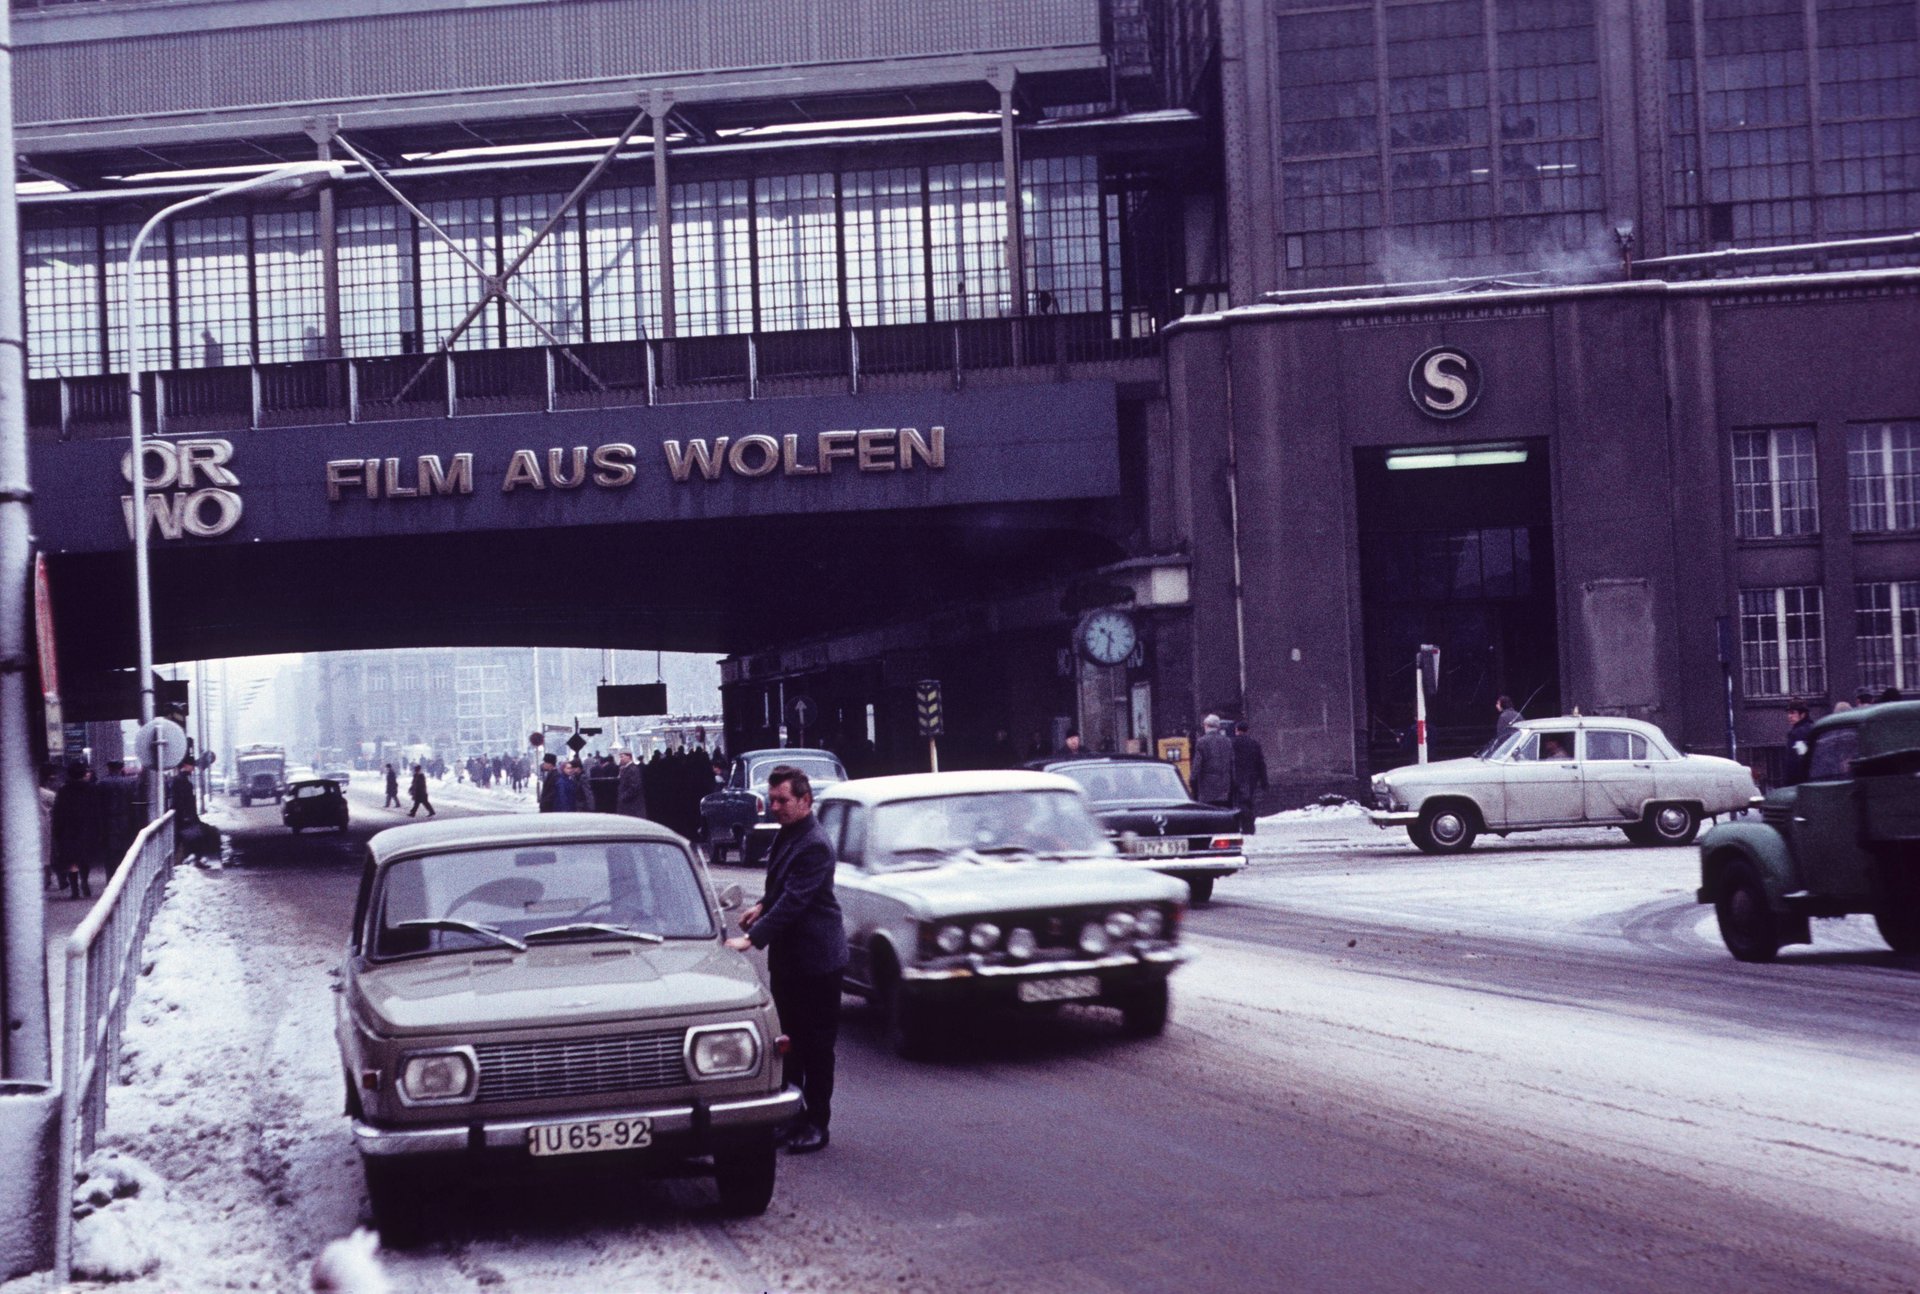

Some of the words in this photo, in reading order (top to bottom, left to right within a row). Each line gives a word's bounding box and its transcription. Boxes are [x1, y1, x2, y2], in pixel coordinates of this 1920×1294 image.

[1423, 352, 1468, 411] S
[121, 438, 240, 490] OR
[326, 452, 474, 501] FILM
[502, 443, 637, 492] AUS
[663, 426, 945, 482] WOLFEN
[120, 487, 243, 541] WO
